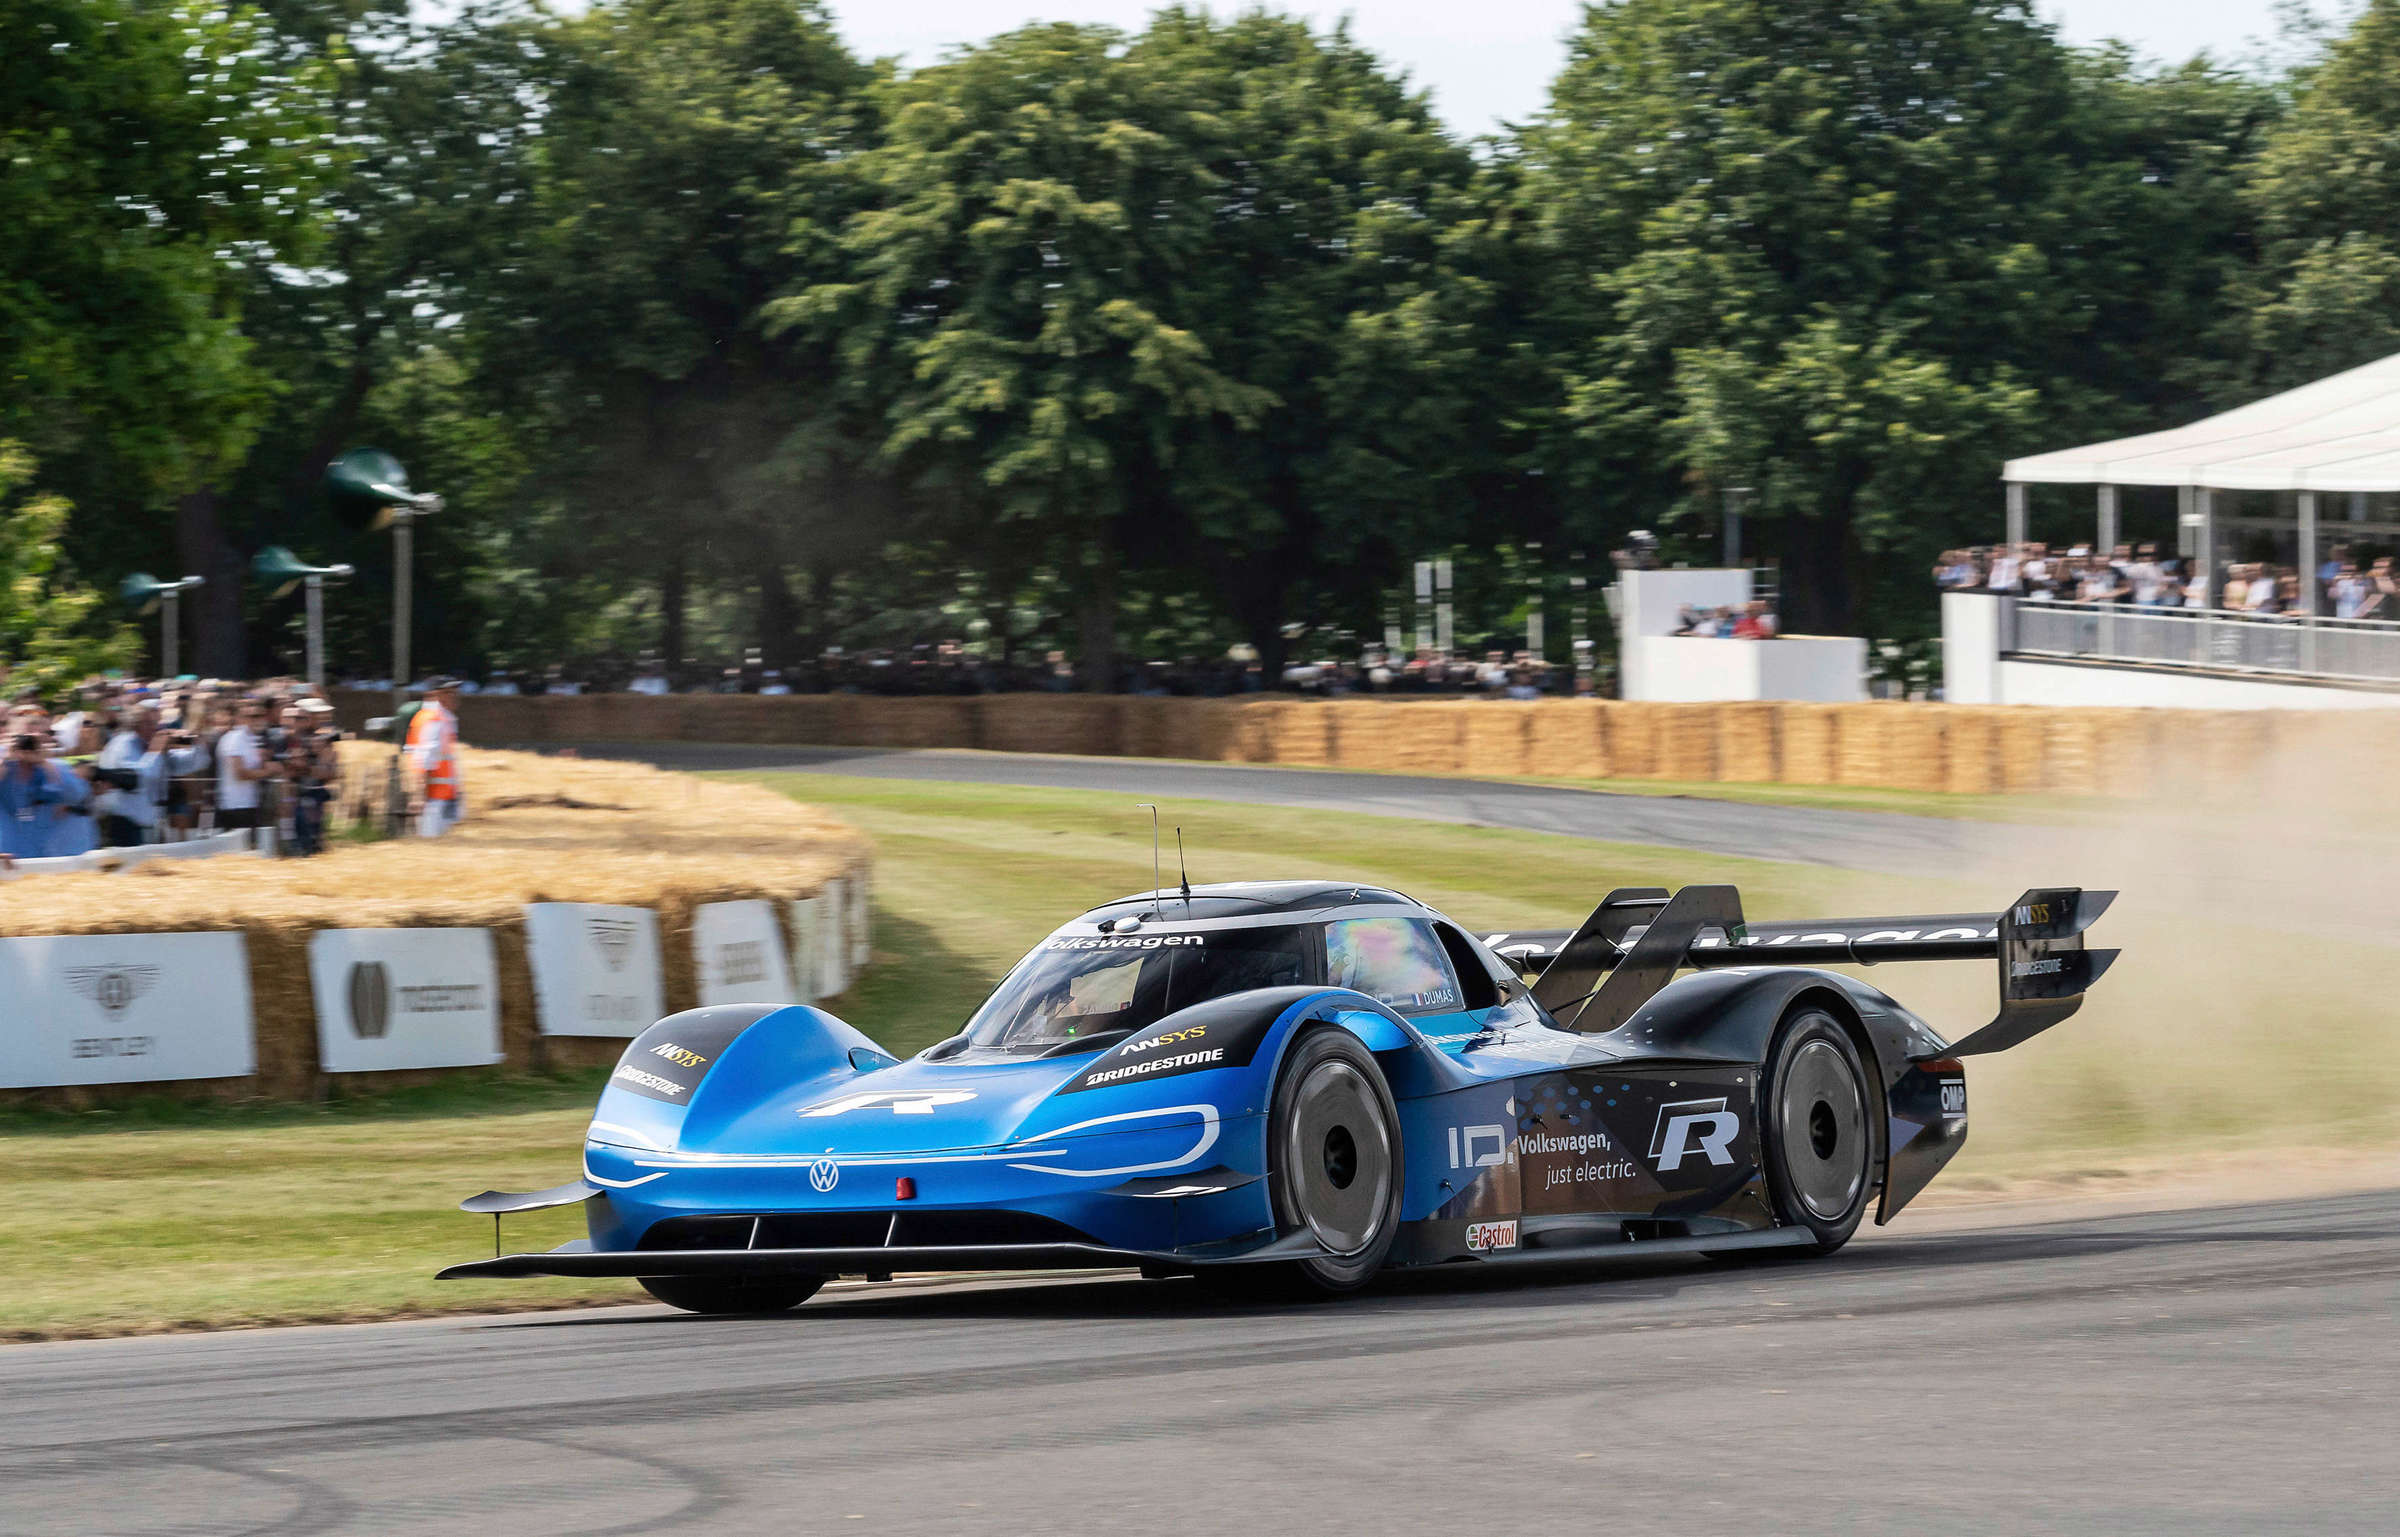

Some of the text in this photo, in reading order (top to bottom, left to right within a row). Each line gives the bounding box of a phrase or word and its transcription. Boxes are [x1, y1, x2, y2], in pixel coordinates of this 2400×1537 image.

[1423, 988, 1454, 1005] DUMAS
[1119, 1025, 1208, 1056] ANSYS
[648, 1042, 707, 1067] ANSYS
[1085, 1047, 1225, 1086] BRIDGESTONE
[1940, 1085, 1965, 1111] OMP
[1517, 1131, 1612, 1156] Volkswagen,
[1648, 1096, 1740, 1172] R
[1544, 1157, 1637, 1190] just electric.
[1478, 1222, 1515, 1248] Castrol
